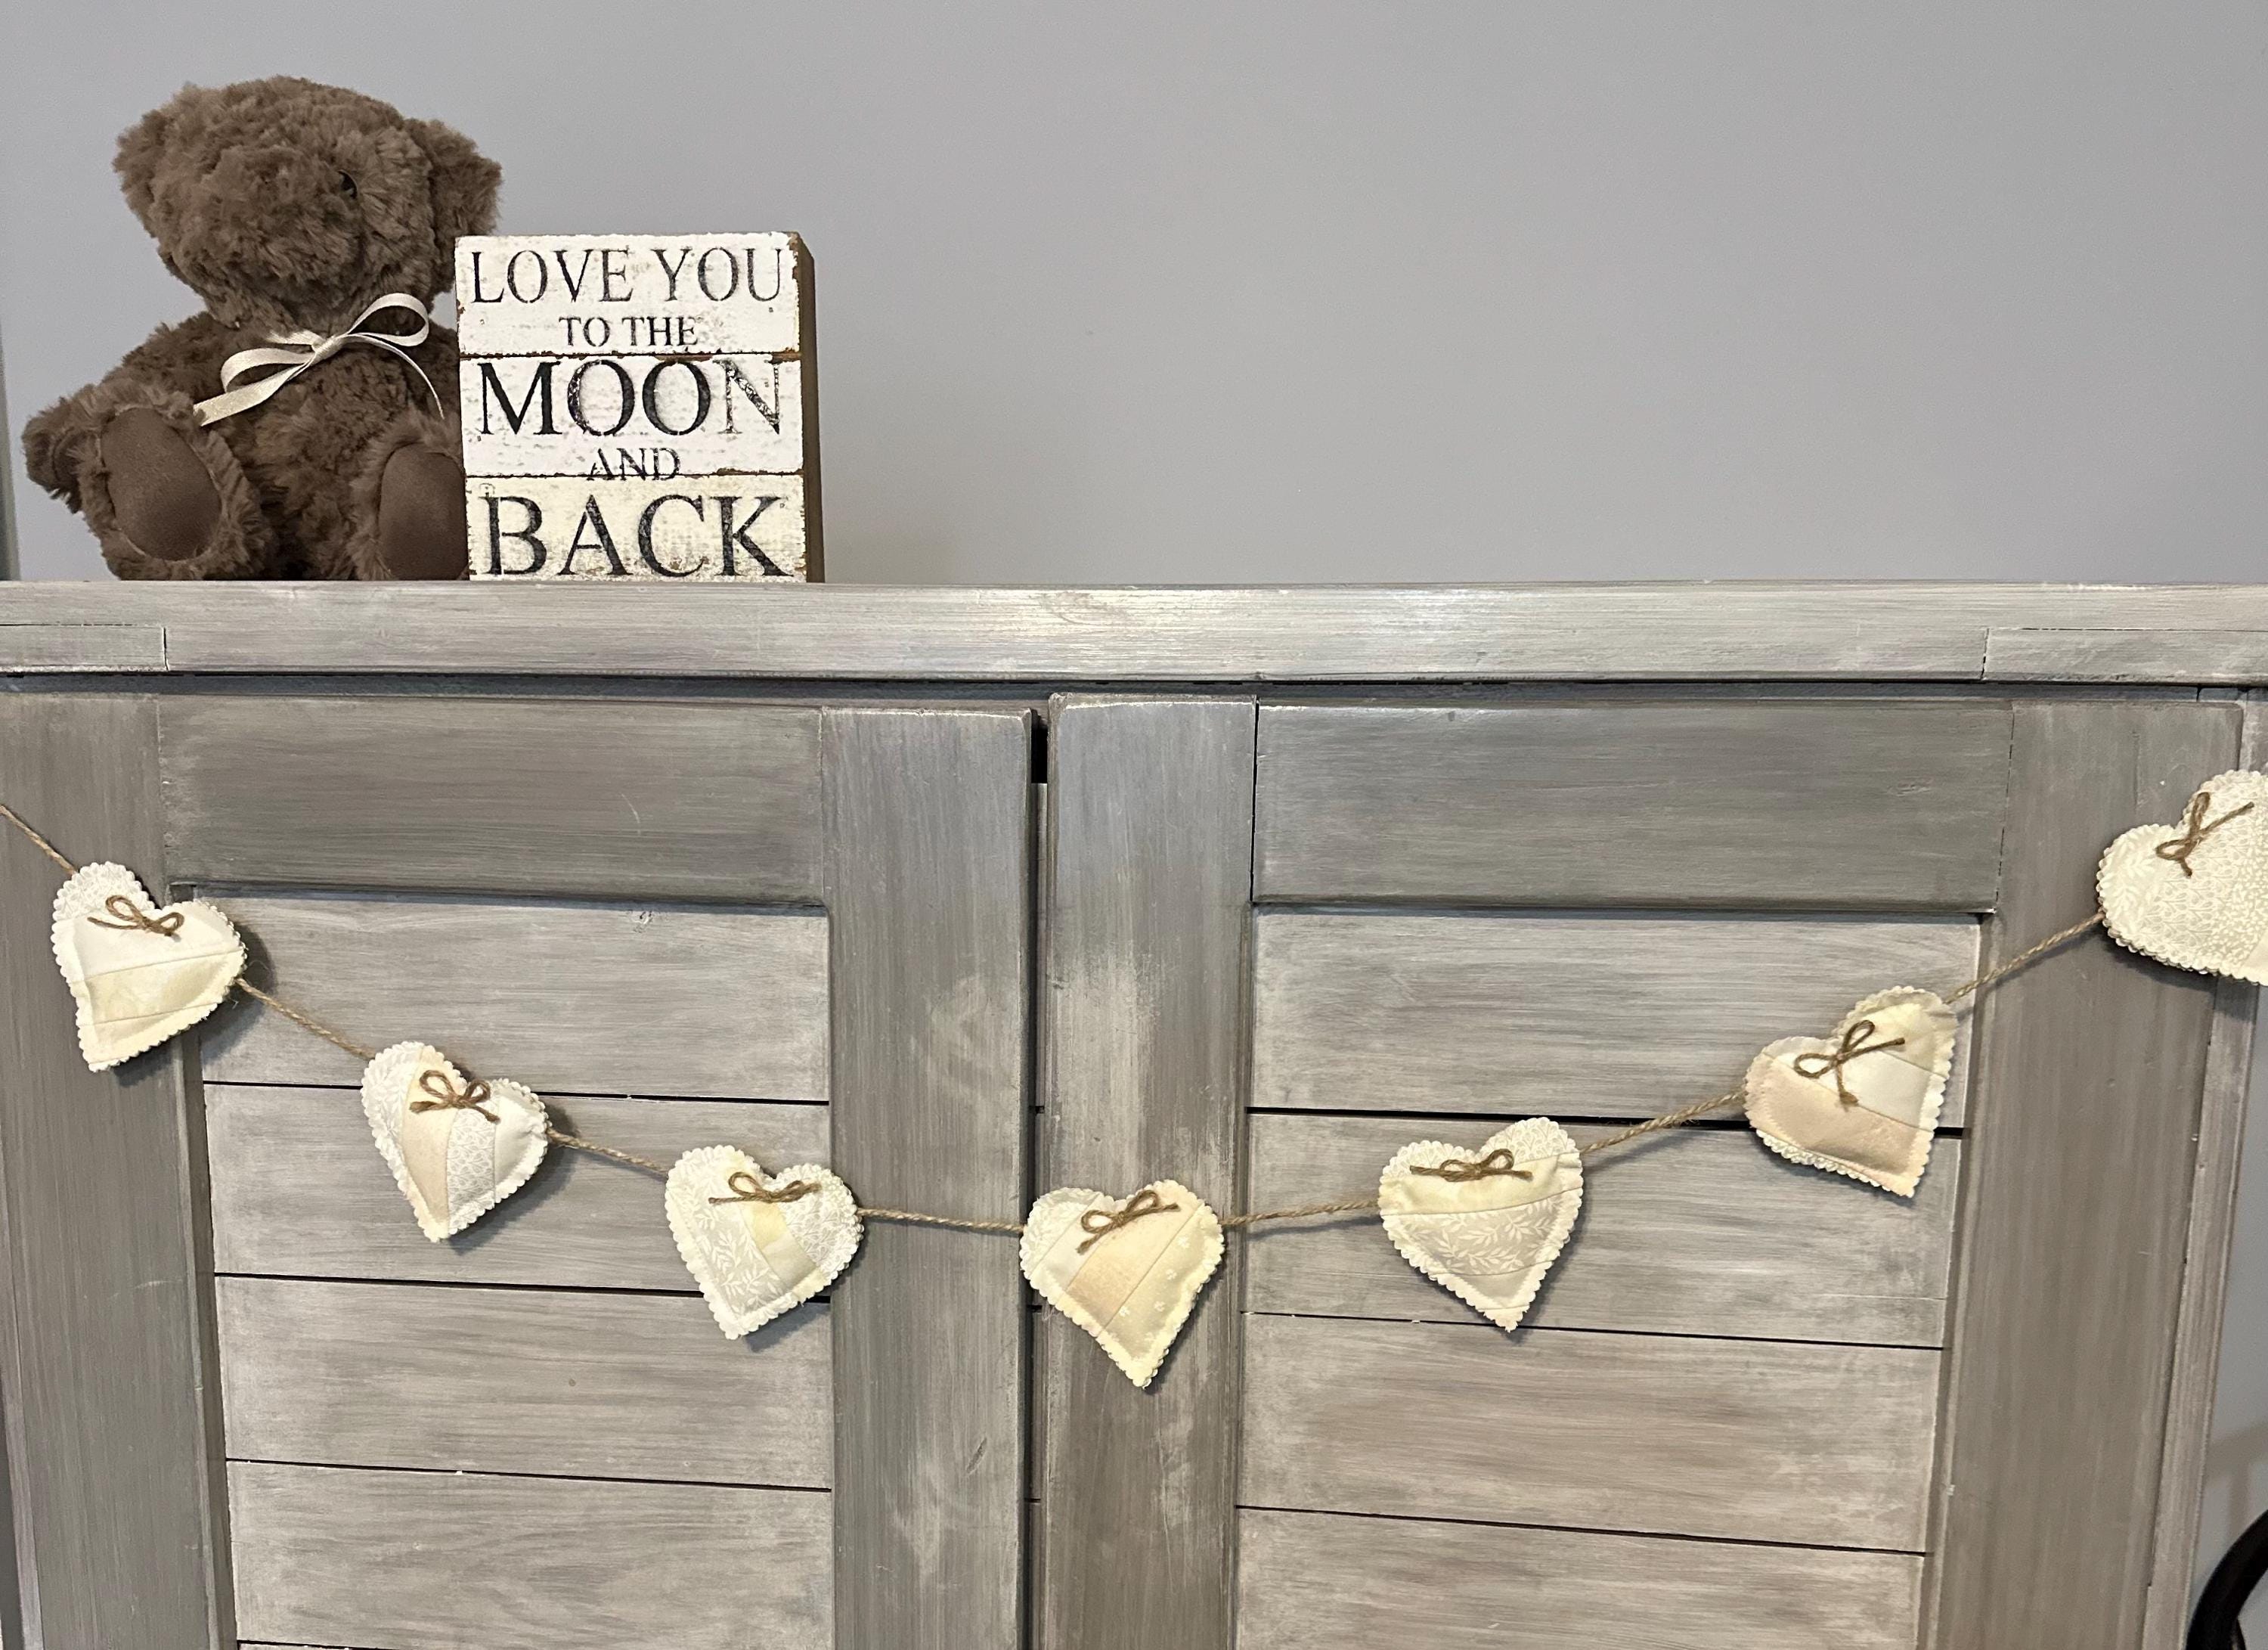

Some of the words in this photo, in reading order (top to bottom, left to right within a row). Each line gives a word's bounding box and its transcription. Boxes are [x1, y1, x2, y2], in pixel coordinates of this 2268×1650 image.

[471, 247, 634, 304] LOVE
[651, 247, 782, 302] YOU
[559, 315, 610, 347] TO
[621, 315, 699, 347] THE
[477, 359, 781, 436] MOON
[587, 447, 681, 481] AND
[479, 495, 794, 577] BACK
